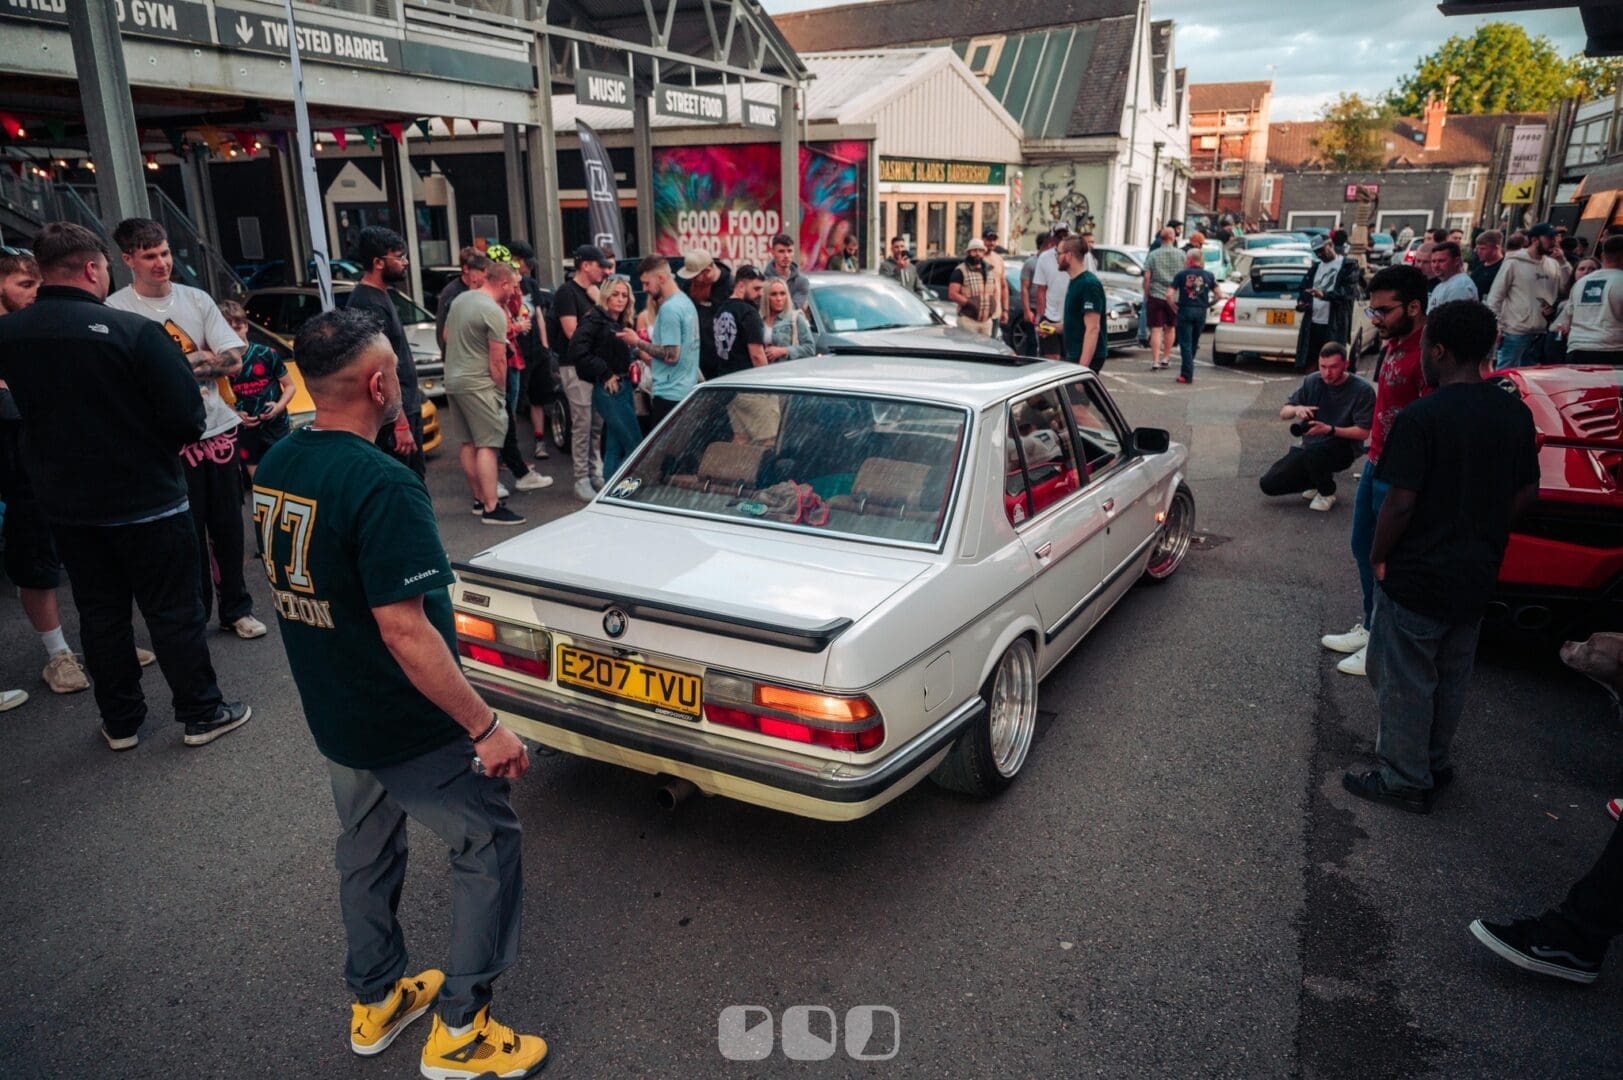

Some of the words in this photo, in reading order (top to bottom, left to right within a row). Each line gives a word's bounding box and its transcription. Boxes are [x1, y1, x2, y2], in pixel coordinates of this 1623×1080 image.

[131, 0, 178, 31] GYM
[261, 20, 332, 54] TWSTED
[333, 33, 389, 63] BARREL
[588, 76, 627, 104] MUSIC
[665, 90, 699, 115] STREET
[700, 94, 723, 118] FOOD
[749, 105, 776, 127] DRINKS
[880, 160, 915, 181] DASHING
[678, 210, 721, 235] GOOD
[728, 210, 779, 235] FOOD
[679, 235, 721, 259] GOOD
[253, 485, 317, 594] 77
[562, 649, 631, 690] E207
[640, 669, 697, 707] TVU
